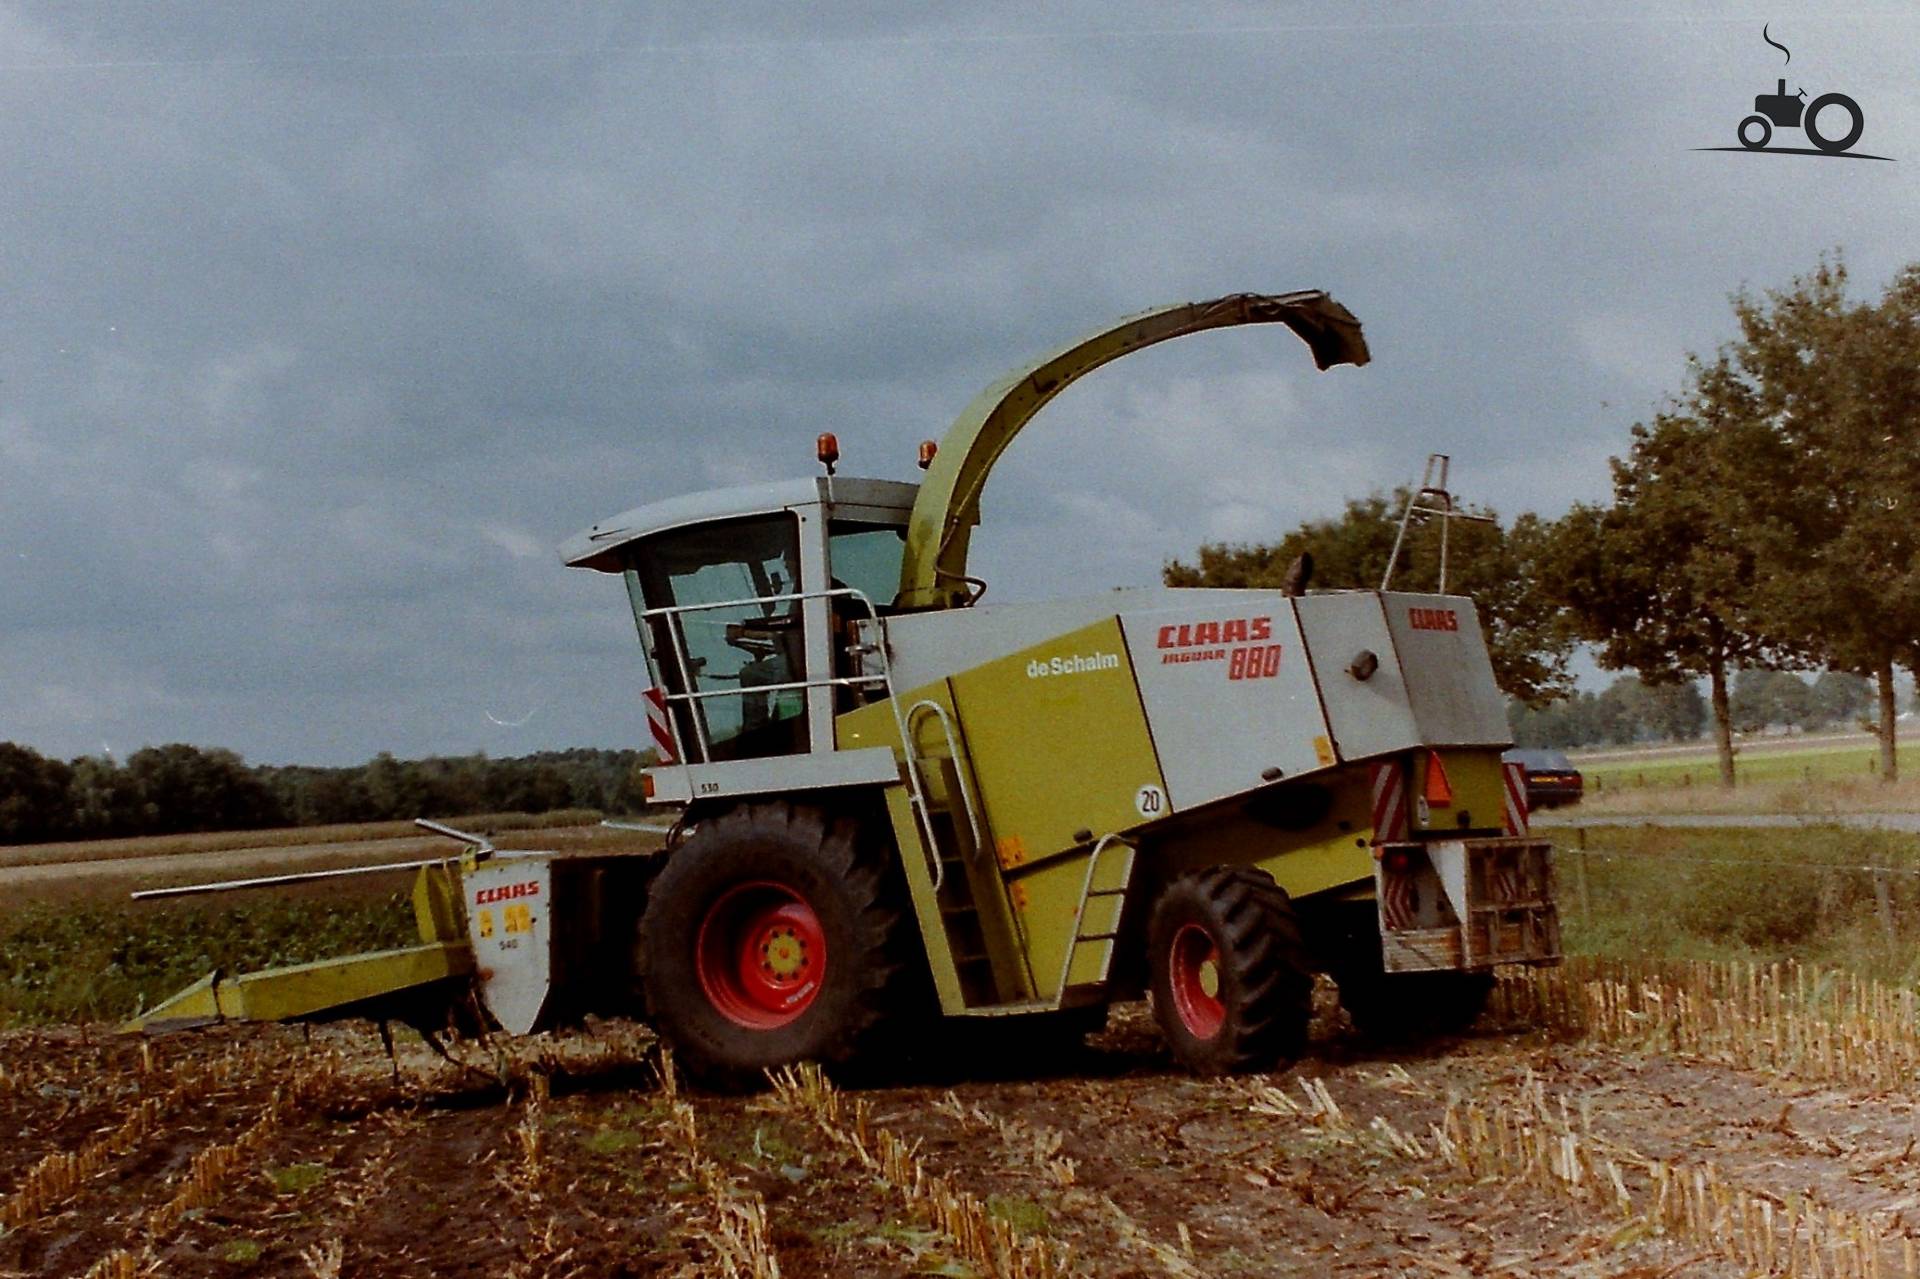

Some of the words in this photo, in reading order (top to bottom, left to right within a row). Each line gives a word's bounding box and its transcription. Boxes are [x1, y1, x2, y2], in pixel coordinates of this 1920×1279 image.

[1409, 608, 1458, 631] CLAAS
[1157, 616, 1271, 649] CLAAS
[1027, 660, 1048, 678] de
[1051, 652, 1119, 675] Schalm
[1229, 644, 1282, 680] 880
[1142, 790, 1160, 812] 20
[476, 880, 540, 905] CLAAS
